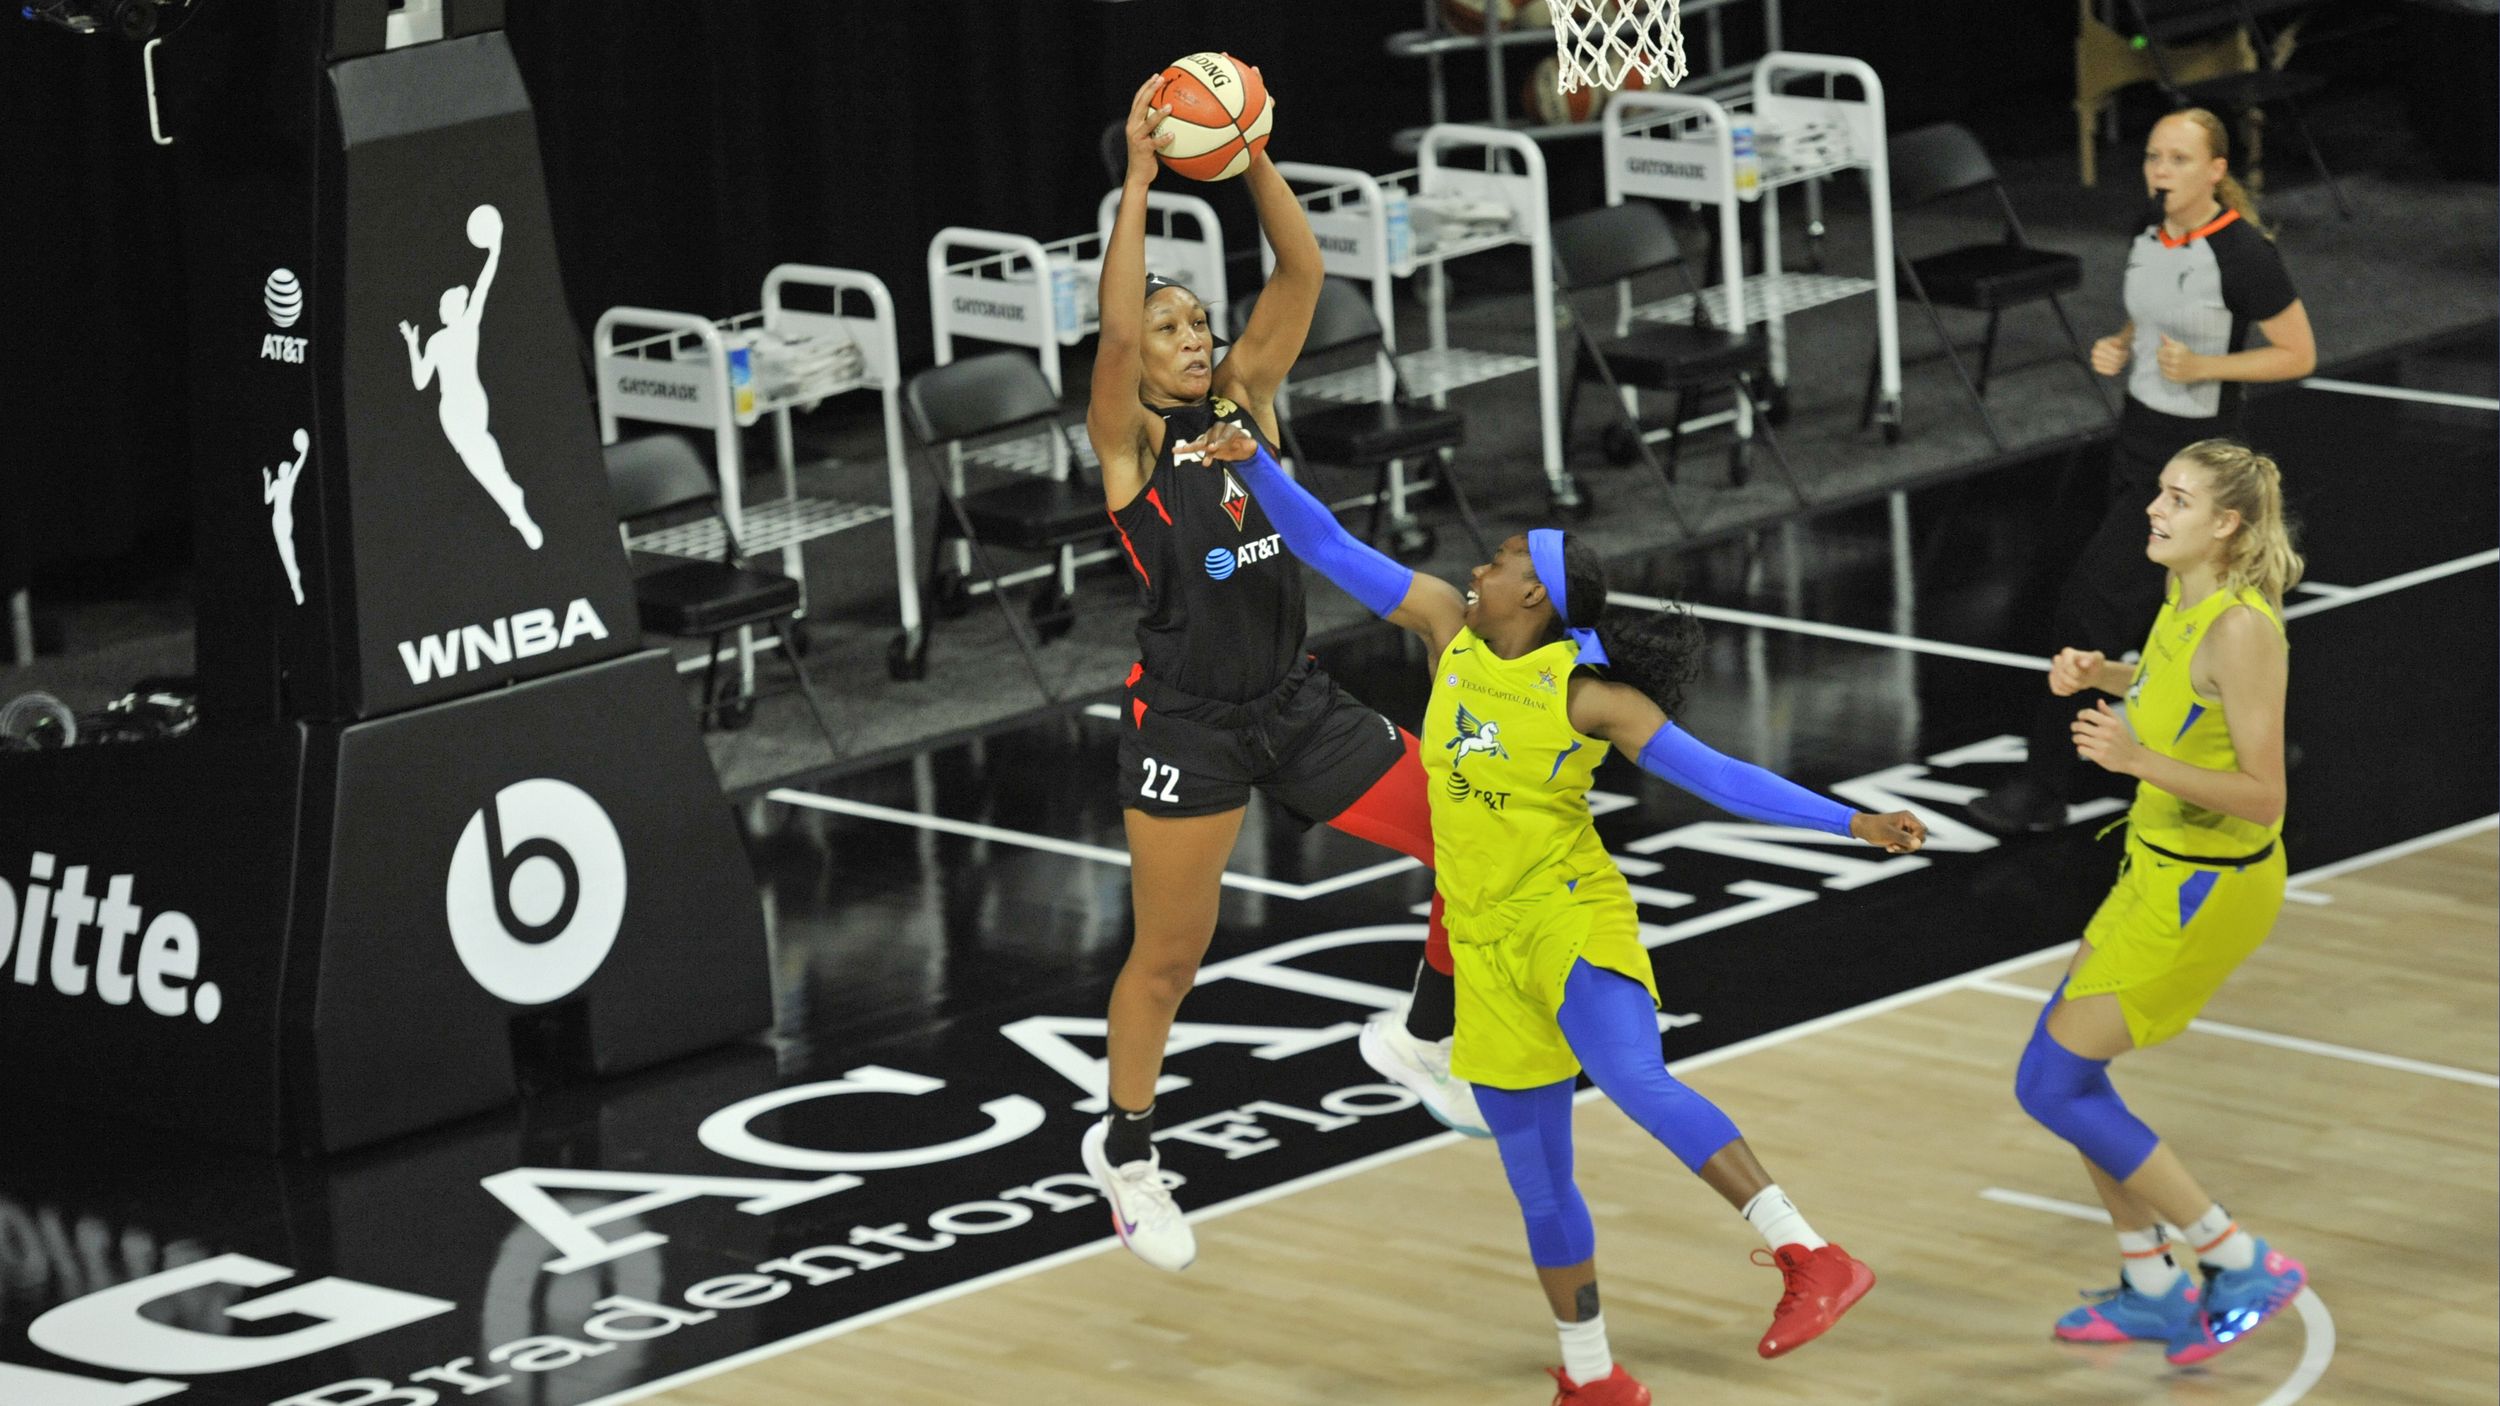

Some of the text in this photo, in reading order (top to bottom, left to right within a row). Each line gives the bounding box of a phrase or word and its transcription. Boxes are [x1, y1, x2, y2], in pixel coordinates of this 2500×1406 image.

[260, 333, 309, 364] AT&T
[618, 376, 698, 401] GATORADE
[1237, 534, 1281, 568] AT&T
[397, 597, 609, 685] WNBA
[1460, 678, 1487, 694] TEXAS
[1487, 688, 1521, 703] CAPITAL
[1522, 697, 1548, 711] BANK
[1140, 757, 1180, 803] 22
